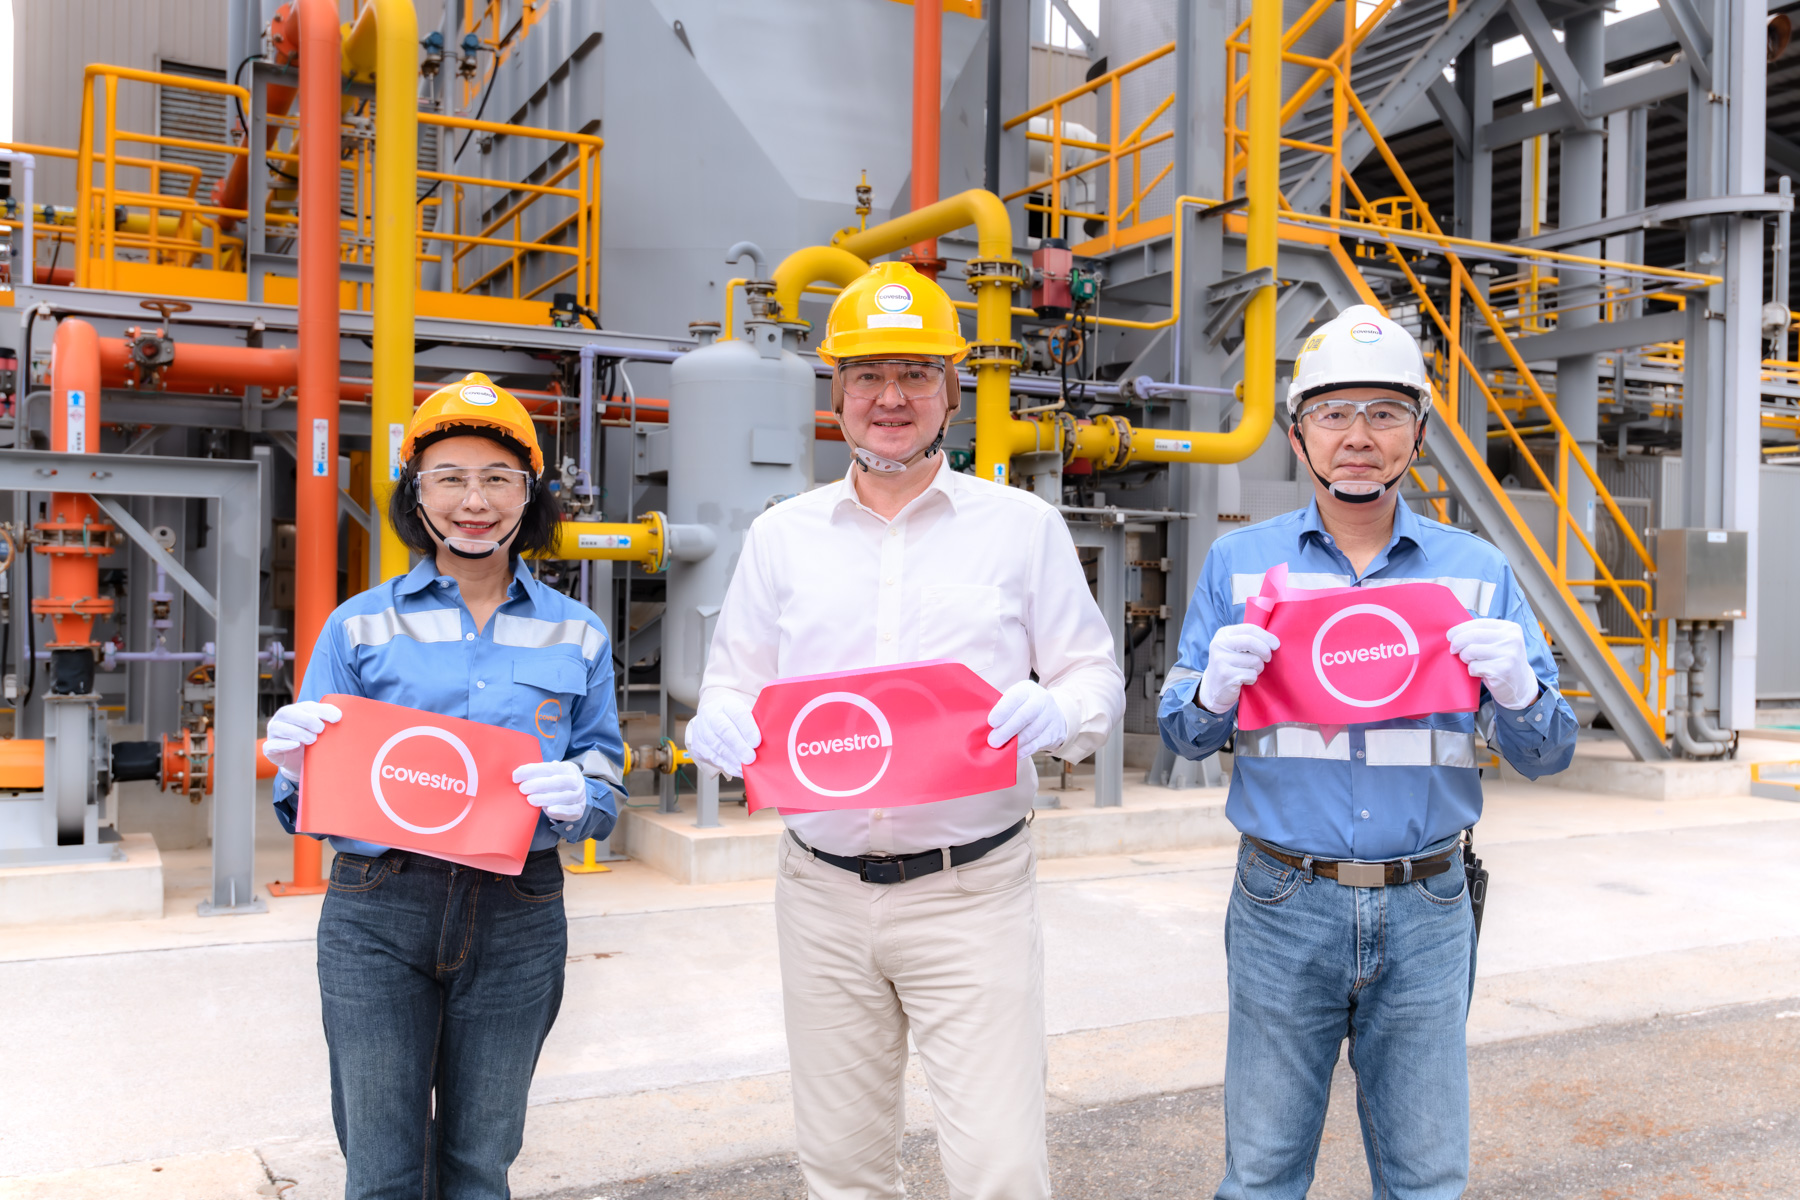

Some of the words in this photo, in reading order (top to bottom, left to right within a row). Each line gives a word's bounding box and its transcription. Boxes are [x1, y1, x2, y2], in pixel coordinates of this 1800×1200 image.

[1321, 643, 1407, 666] covestro
[797, 733, 880, 757] covestro
[381, 764, 466, 794] covestro
